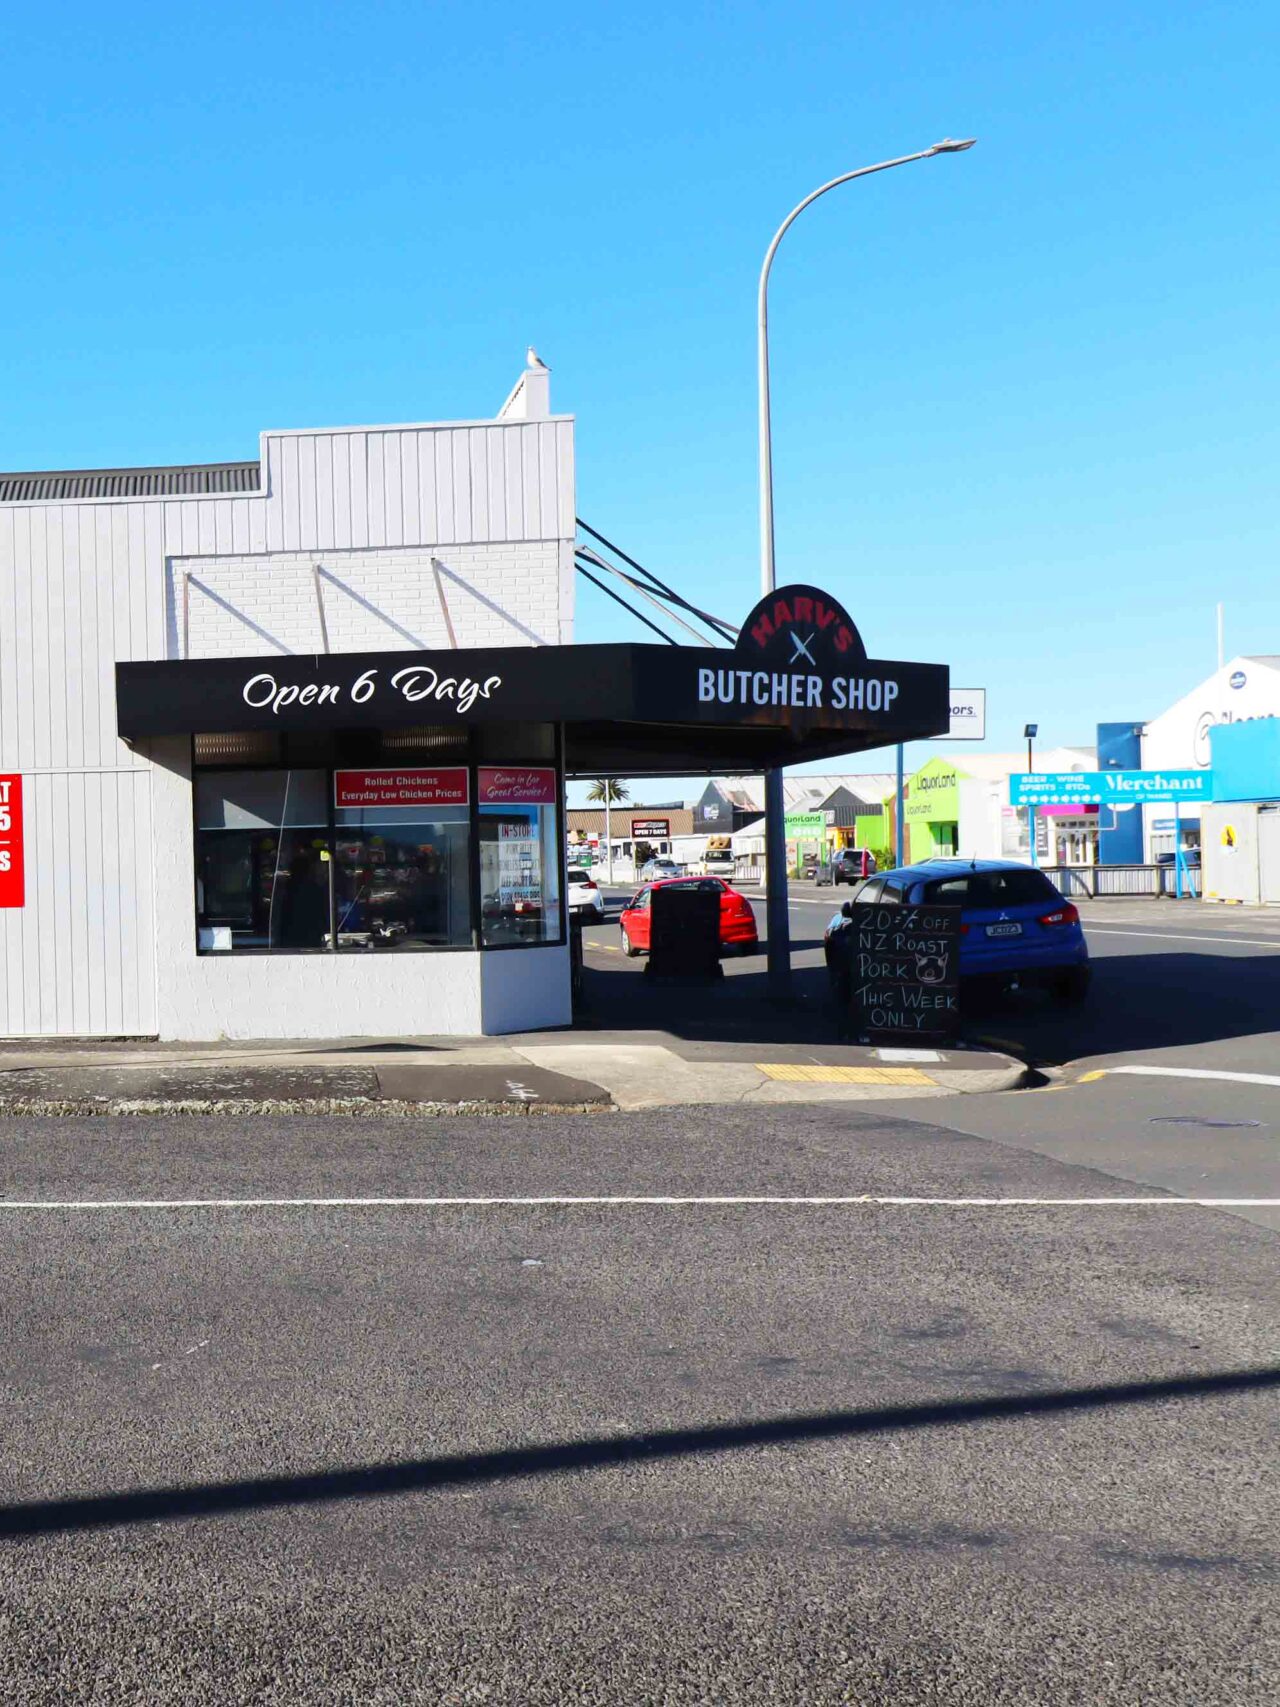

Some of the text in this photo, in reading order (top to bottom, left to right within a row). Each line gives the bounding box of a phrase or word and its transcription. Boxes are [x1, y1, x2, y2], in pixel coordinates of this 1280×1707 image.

[751, 596, 853, 652] HARV'S
[243, 666, 501, 714] Open 6 Days
[698, 668, 899, 712] BUTCHER SHOP
[364, 776, 439, 786] Rolled Chickens
[494, 773, 516, 784] Come
[526, 773, 540, 786] for
[1021, 774, 1084, 783] BEER WINE
[1105, 774, 1203, 791] Merchant
[486, 786, 512, 798] Great
[1018, 783, 1056, 791] SPIRITS
[341, 789, 462, 801] Everyday Low Chicken Prices
[923, 918, 951, 930] OFF
[859, 932, 888, 950] NZ
[871, 1008, 926, 1029] ONLY
